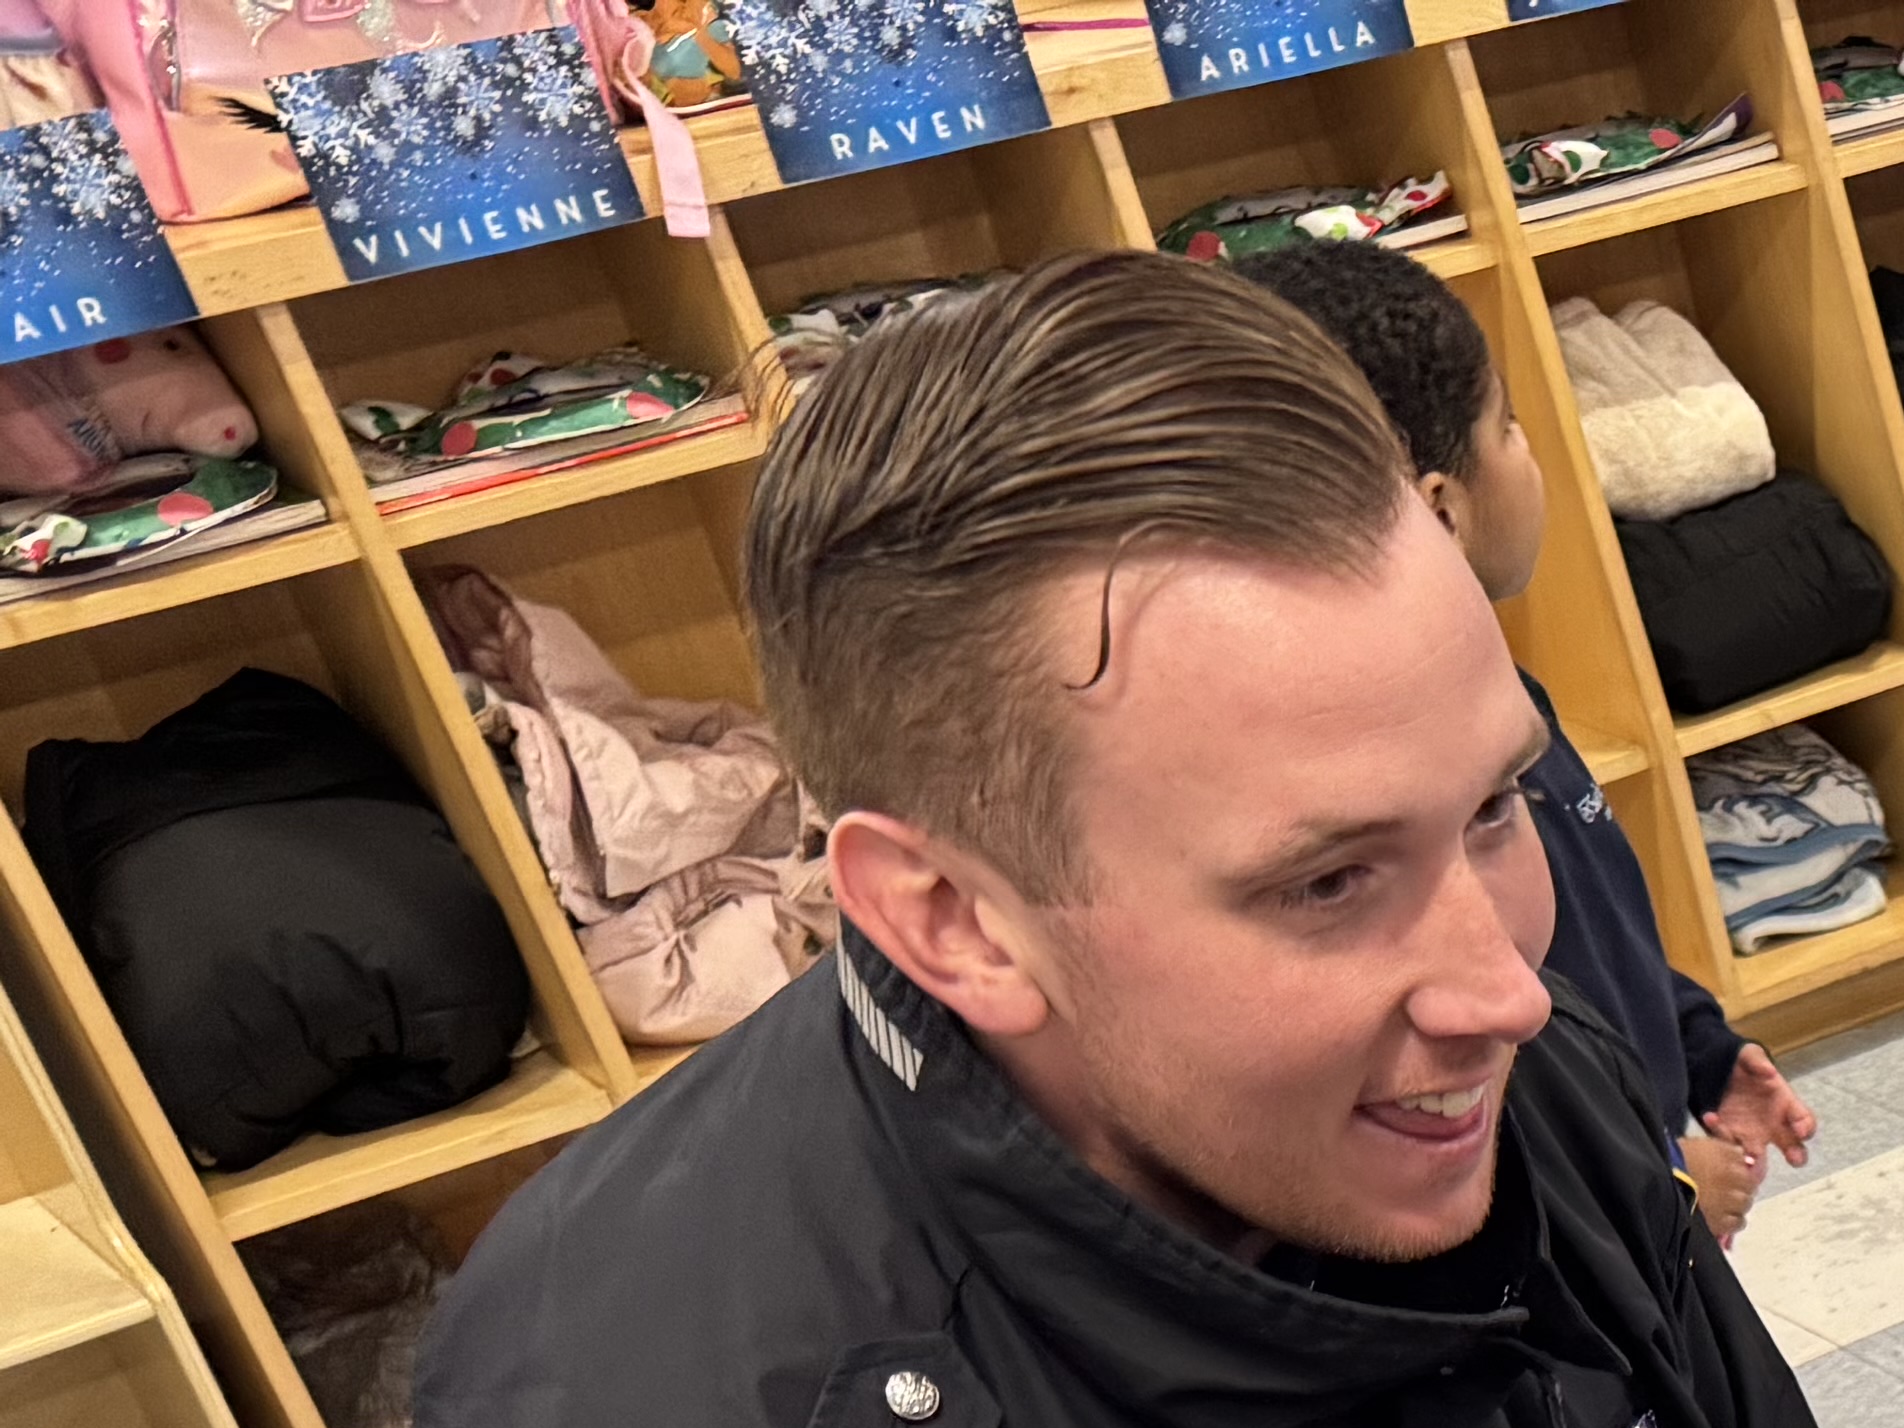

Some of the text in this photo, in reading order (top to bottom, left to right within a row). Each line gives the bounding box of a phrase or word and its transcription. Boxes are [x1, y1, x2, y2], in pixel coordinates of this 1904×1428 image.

[1200, 20, 1376, 81] ARIELLA
[829, 104, 986, 160] RAVEN
[352, 188, 616, 264] VIVIENNE
[14, 297, 108, 342] AIR
